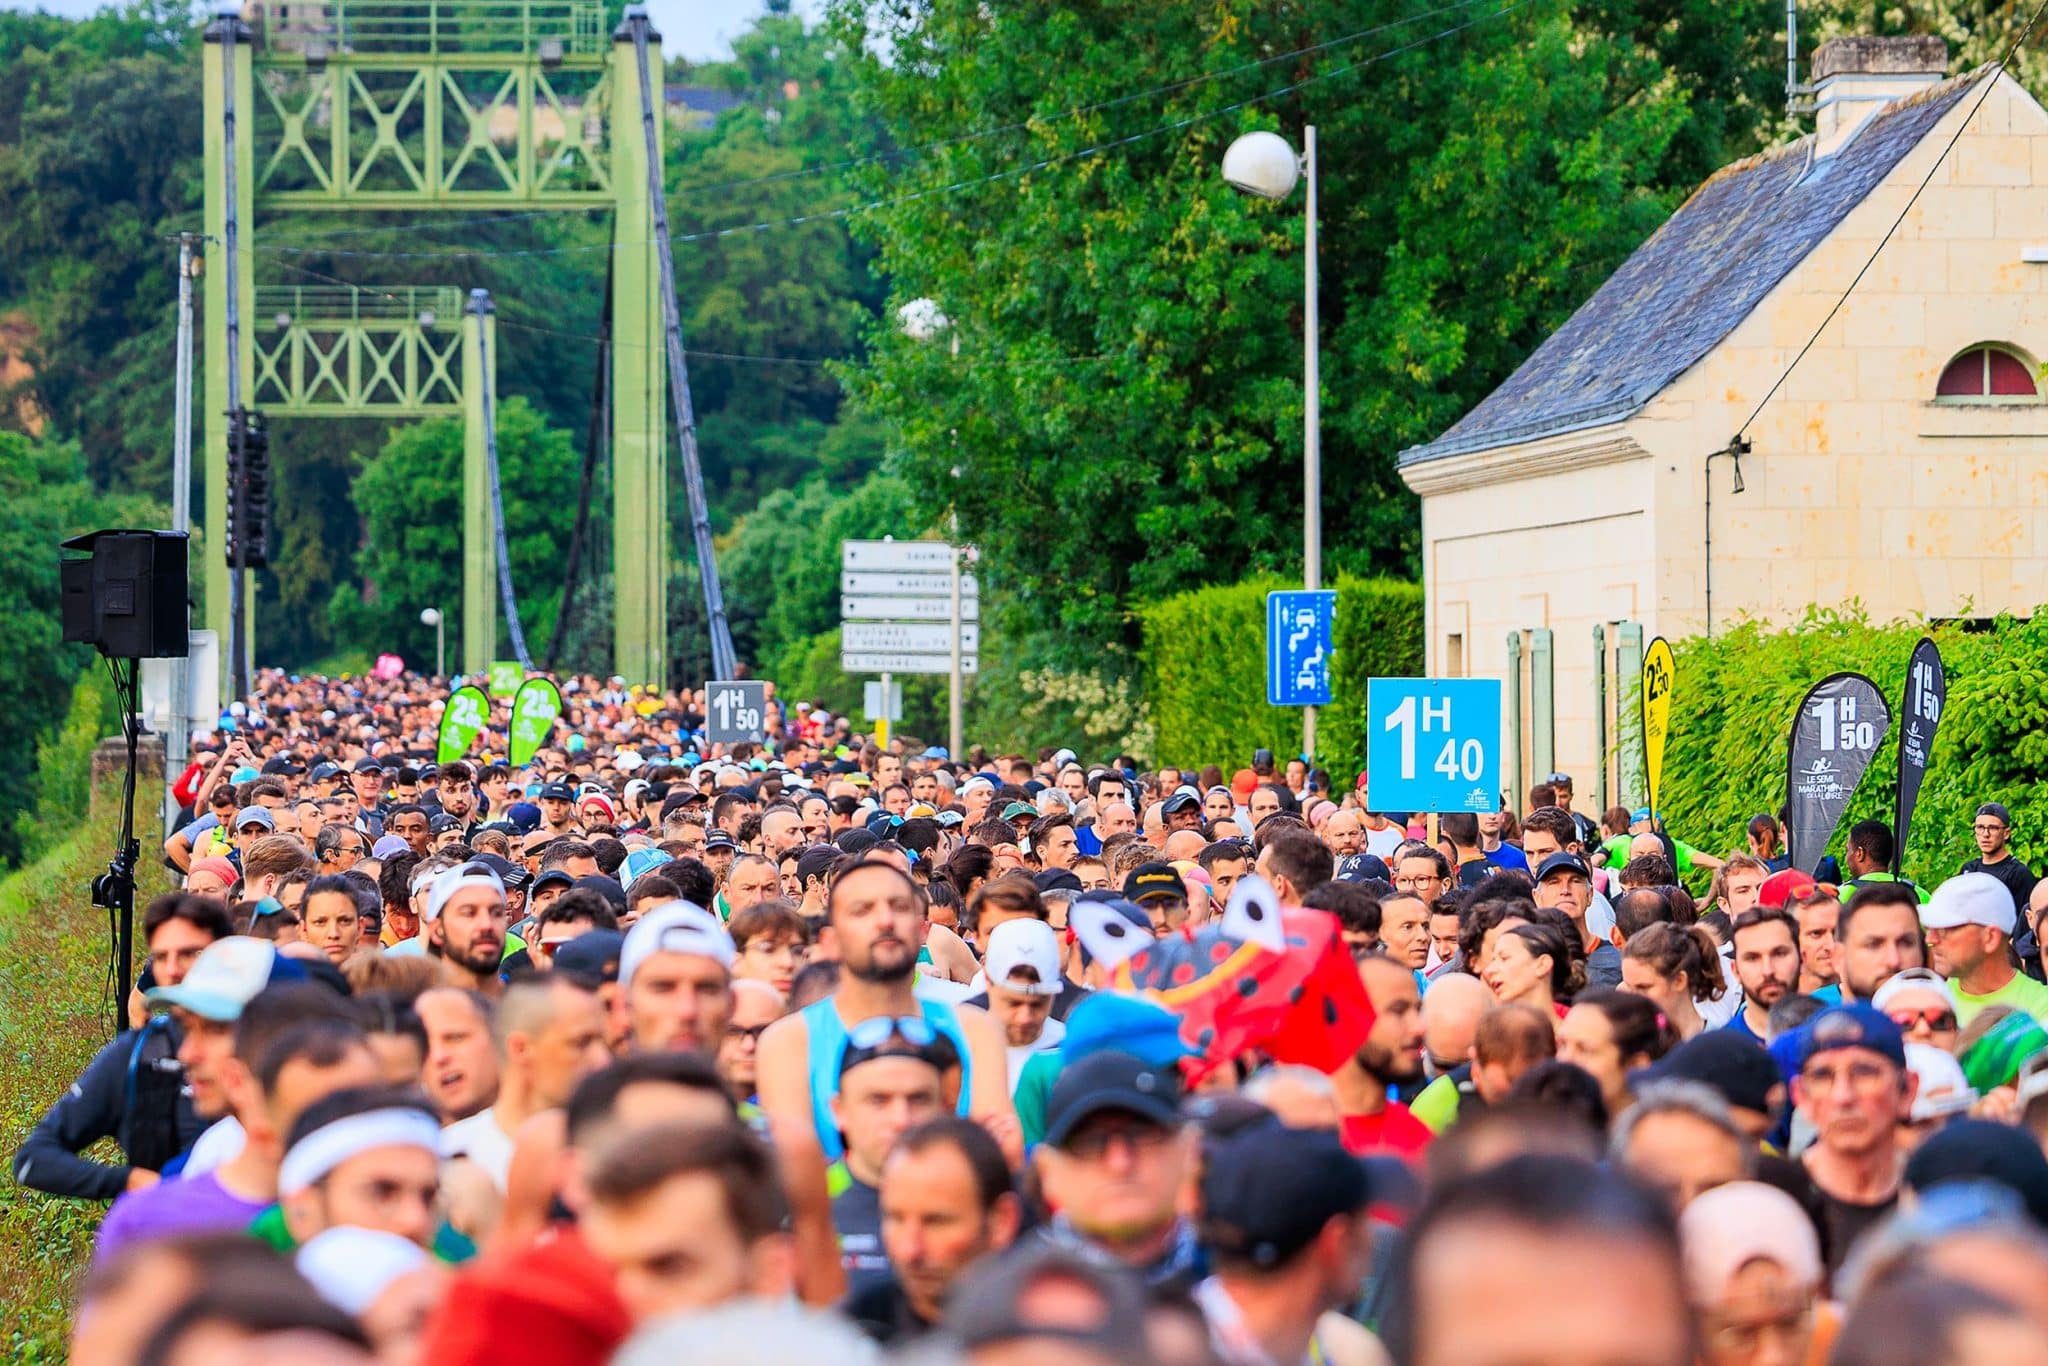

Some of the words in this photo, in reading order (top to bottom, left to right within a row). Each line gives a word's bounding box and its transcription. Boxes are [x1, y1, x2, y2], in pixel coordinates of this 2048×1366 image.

[1806, 775, 1816, 784] LE
[1816, 775, 1834, 783] SEMI
[1798, 782, 1843, 793] MARATHON
[1821, 791, 1842, 800] LOIRE
